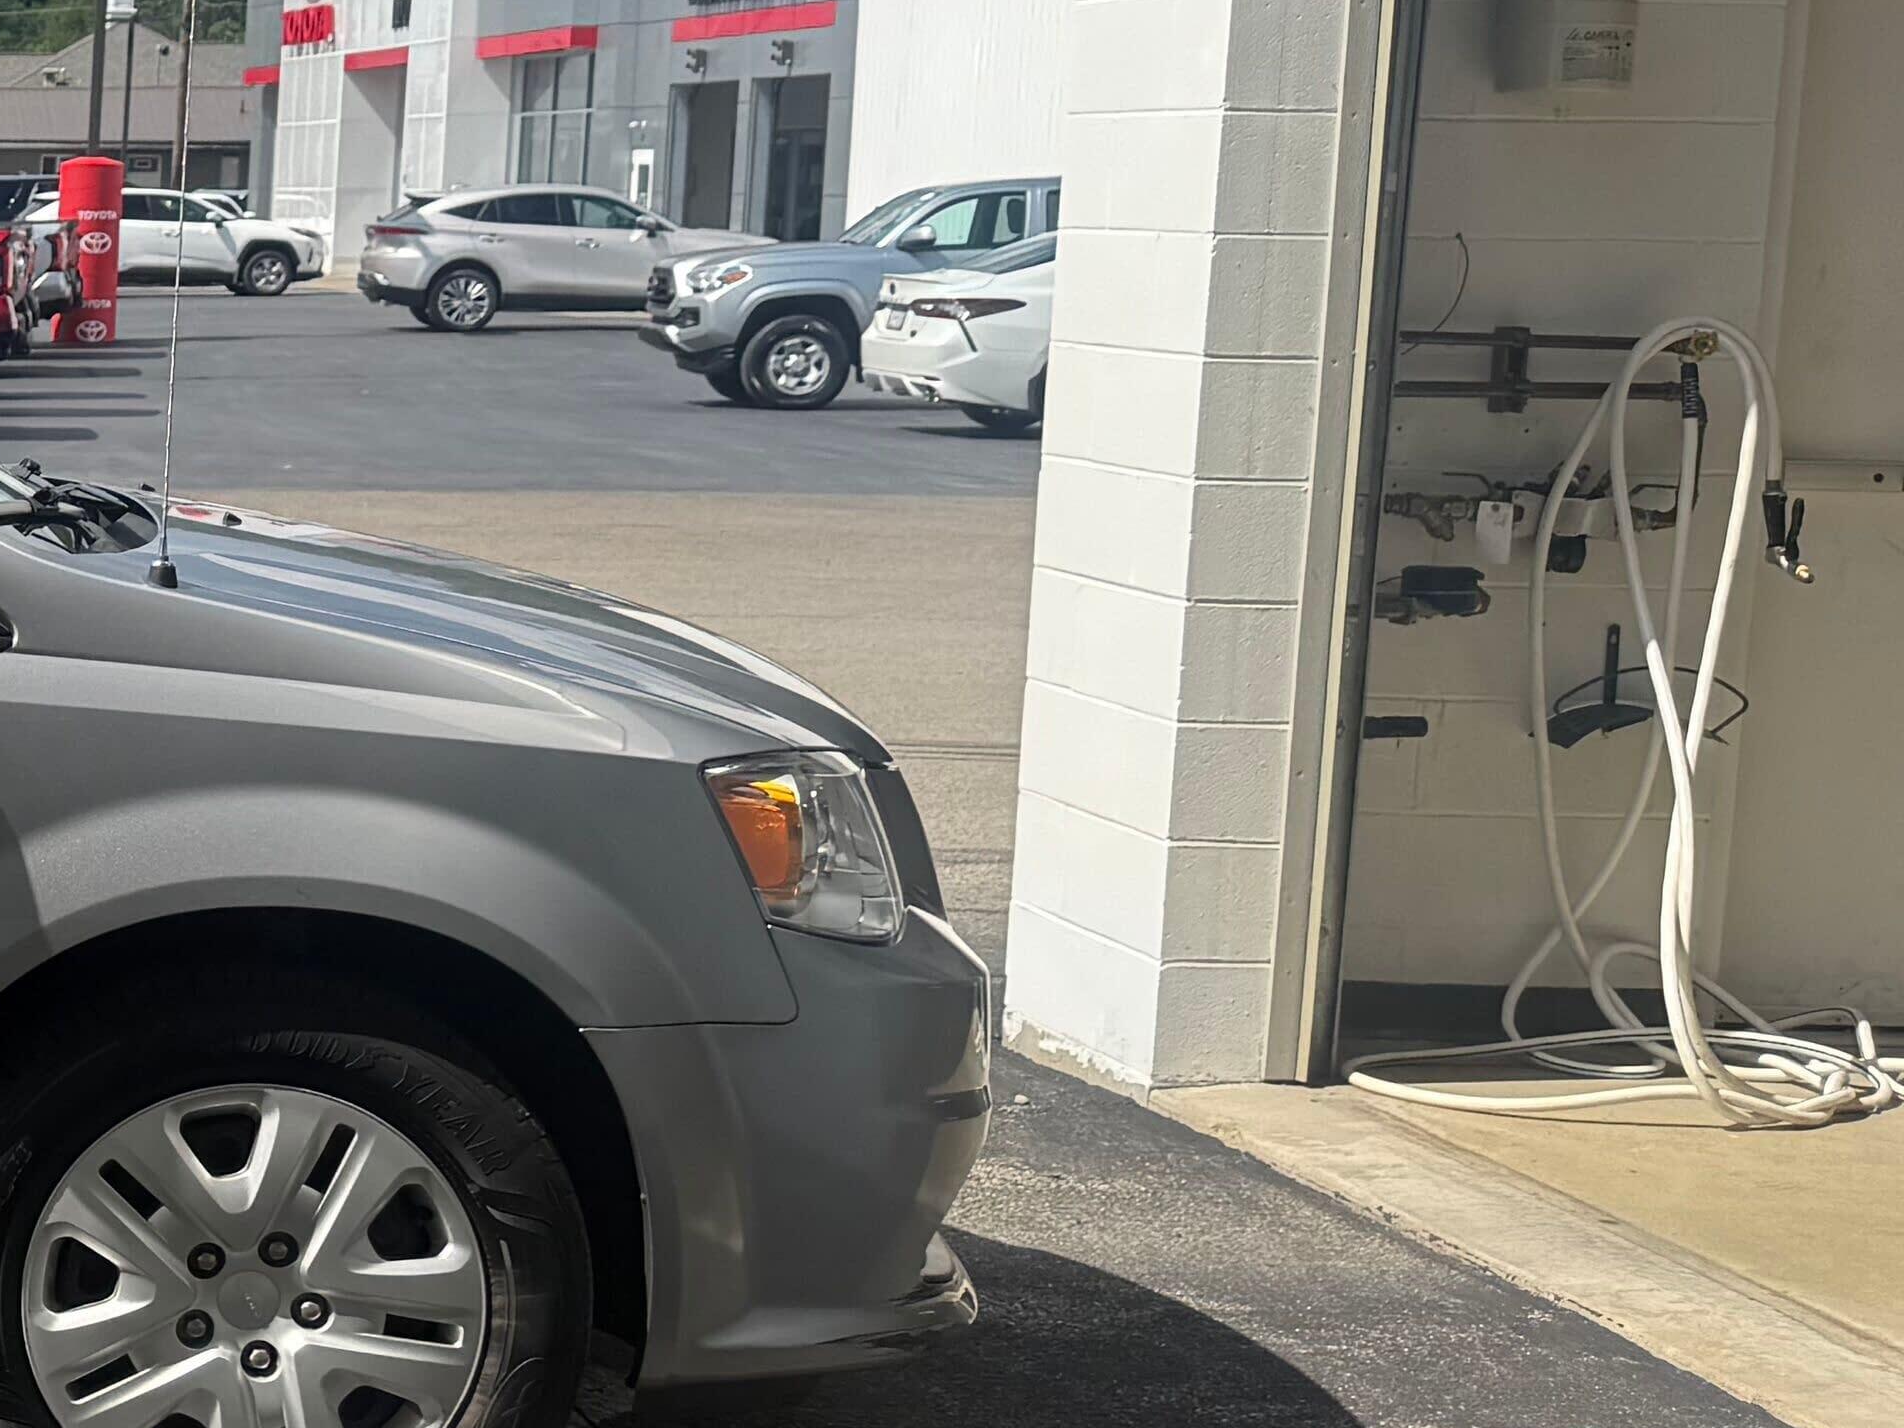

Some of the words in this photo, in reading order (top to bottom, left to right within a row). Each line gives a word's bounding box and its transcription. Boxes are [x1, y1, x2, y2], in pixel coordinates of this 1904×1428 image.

[282, 5, 334, 45] TOYOTA
[78, 210, 117, 220] TOYOTA
[236, 1029, 512, 1177] OODYEAR
